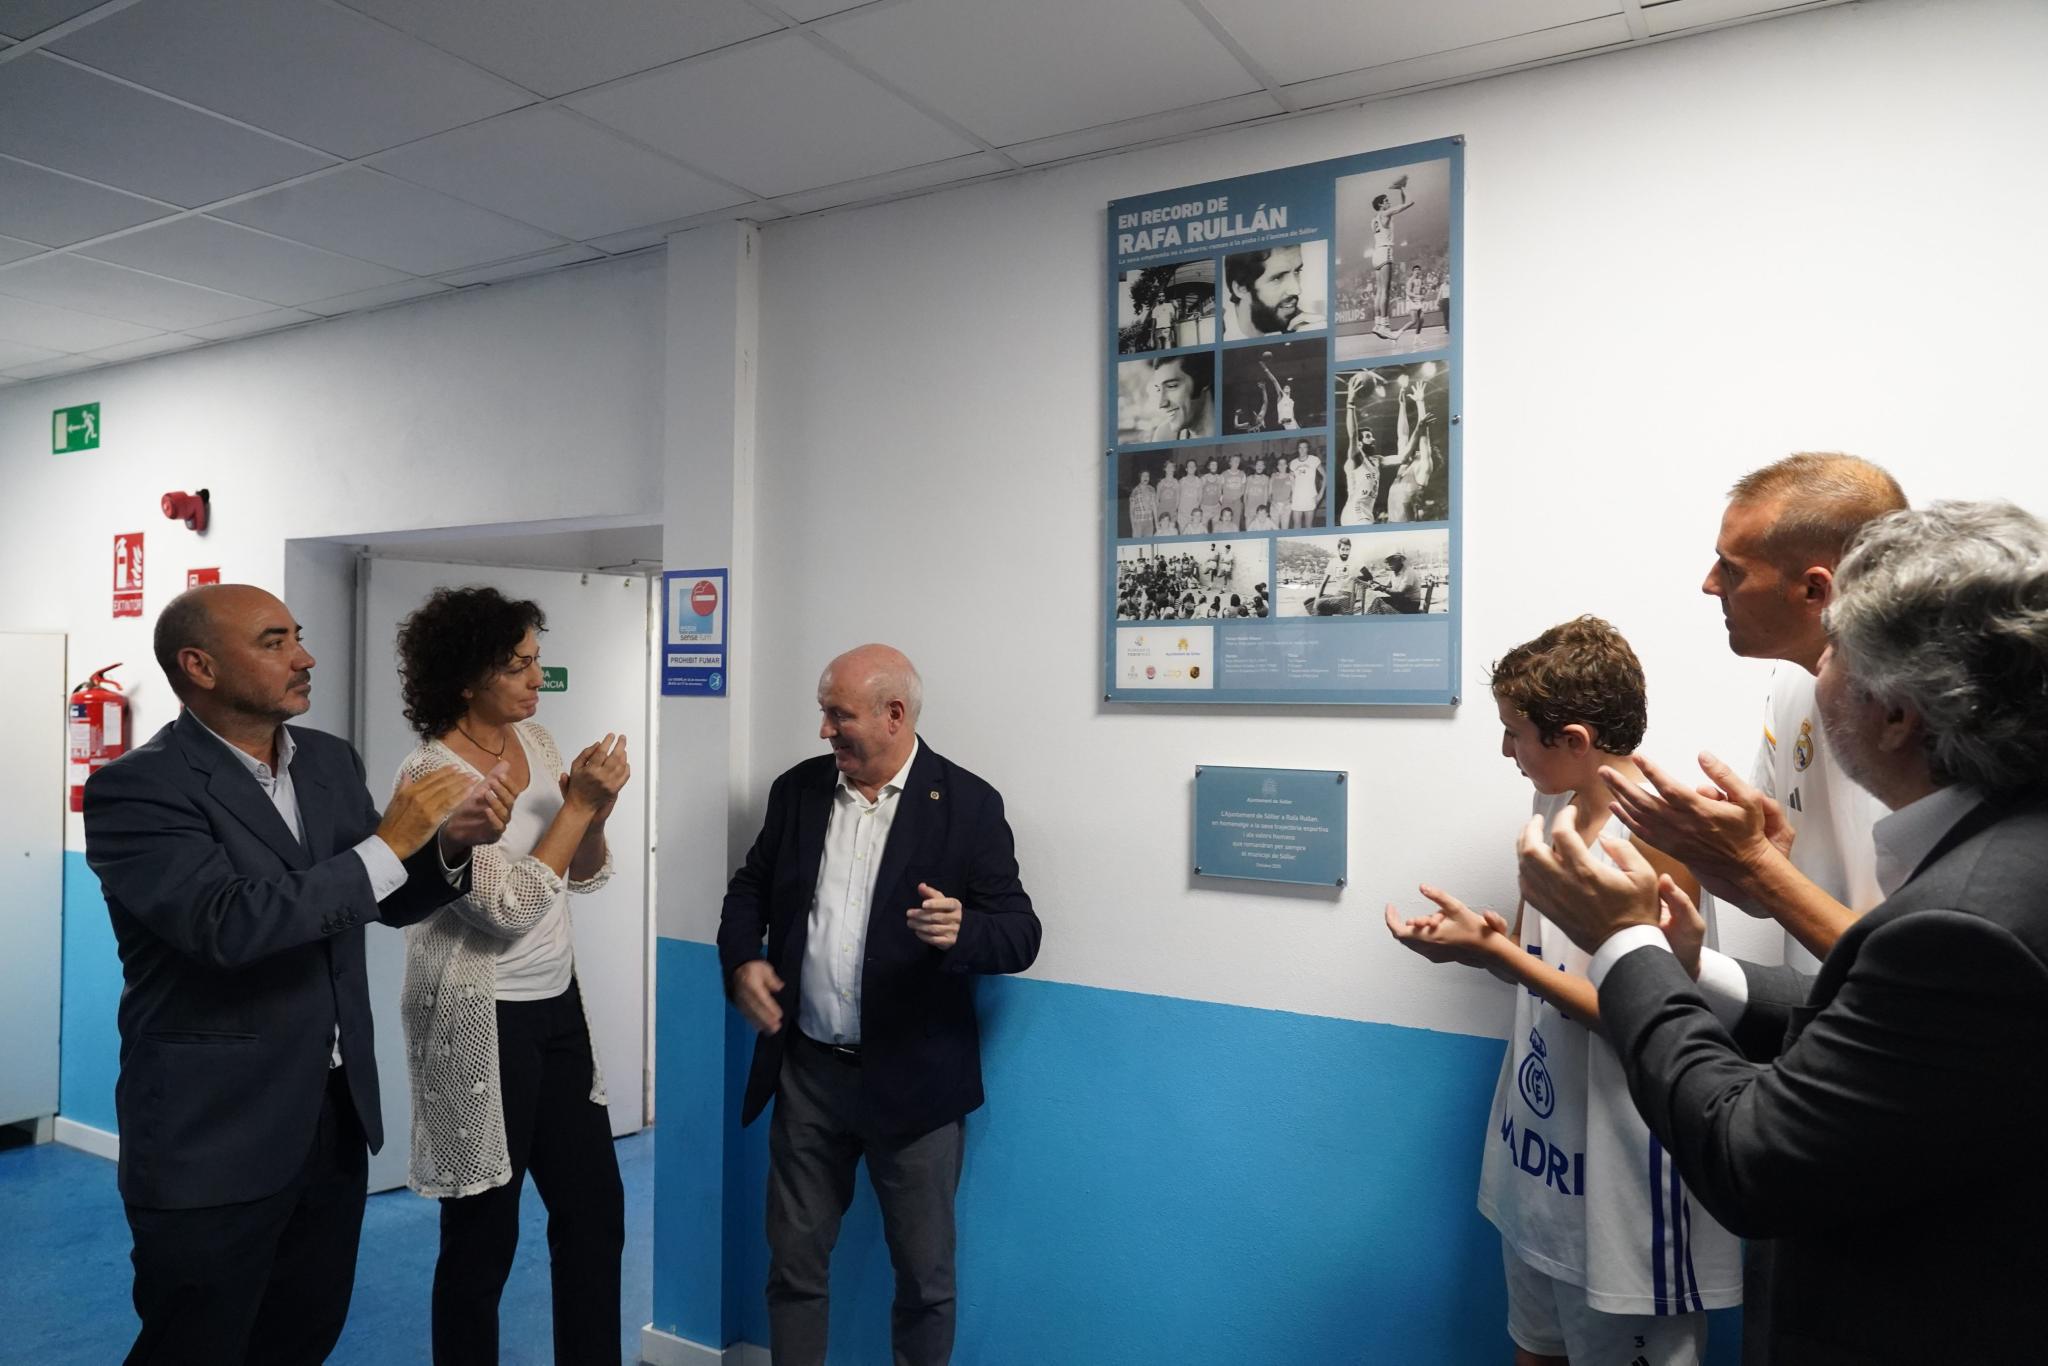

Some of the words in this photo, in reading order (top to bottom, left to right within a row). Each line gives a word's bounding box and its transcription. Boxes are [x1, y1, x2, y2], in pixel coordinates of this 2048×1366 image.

[1118, 212, 1138, 229] EN
[1141, 201, 1204, 226] RECORD
[1207, 196, 1228, 214] DE
[1118, 225, 1182, 255] RAFA
[1187, 203, 1288, 244] RULLÁN
[670, 656, 697, 664] PROHIBIT
[699, 656, 720, 664] FUMAR
[1303, 825, 1329, 833] esportiva
[1633, 1335, 1646, 1348] 3
